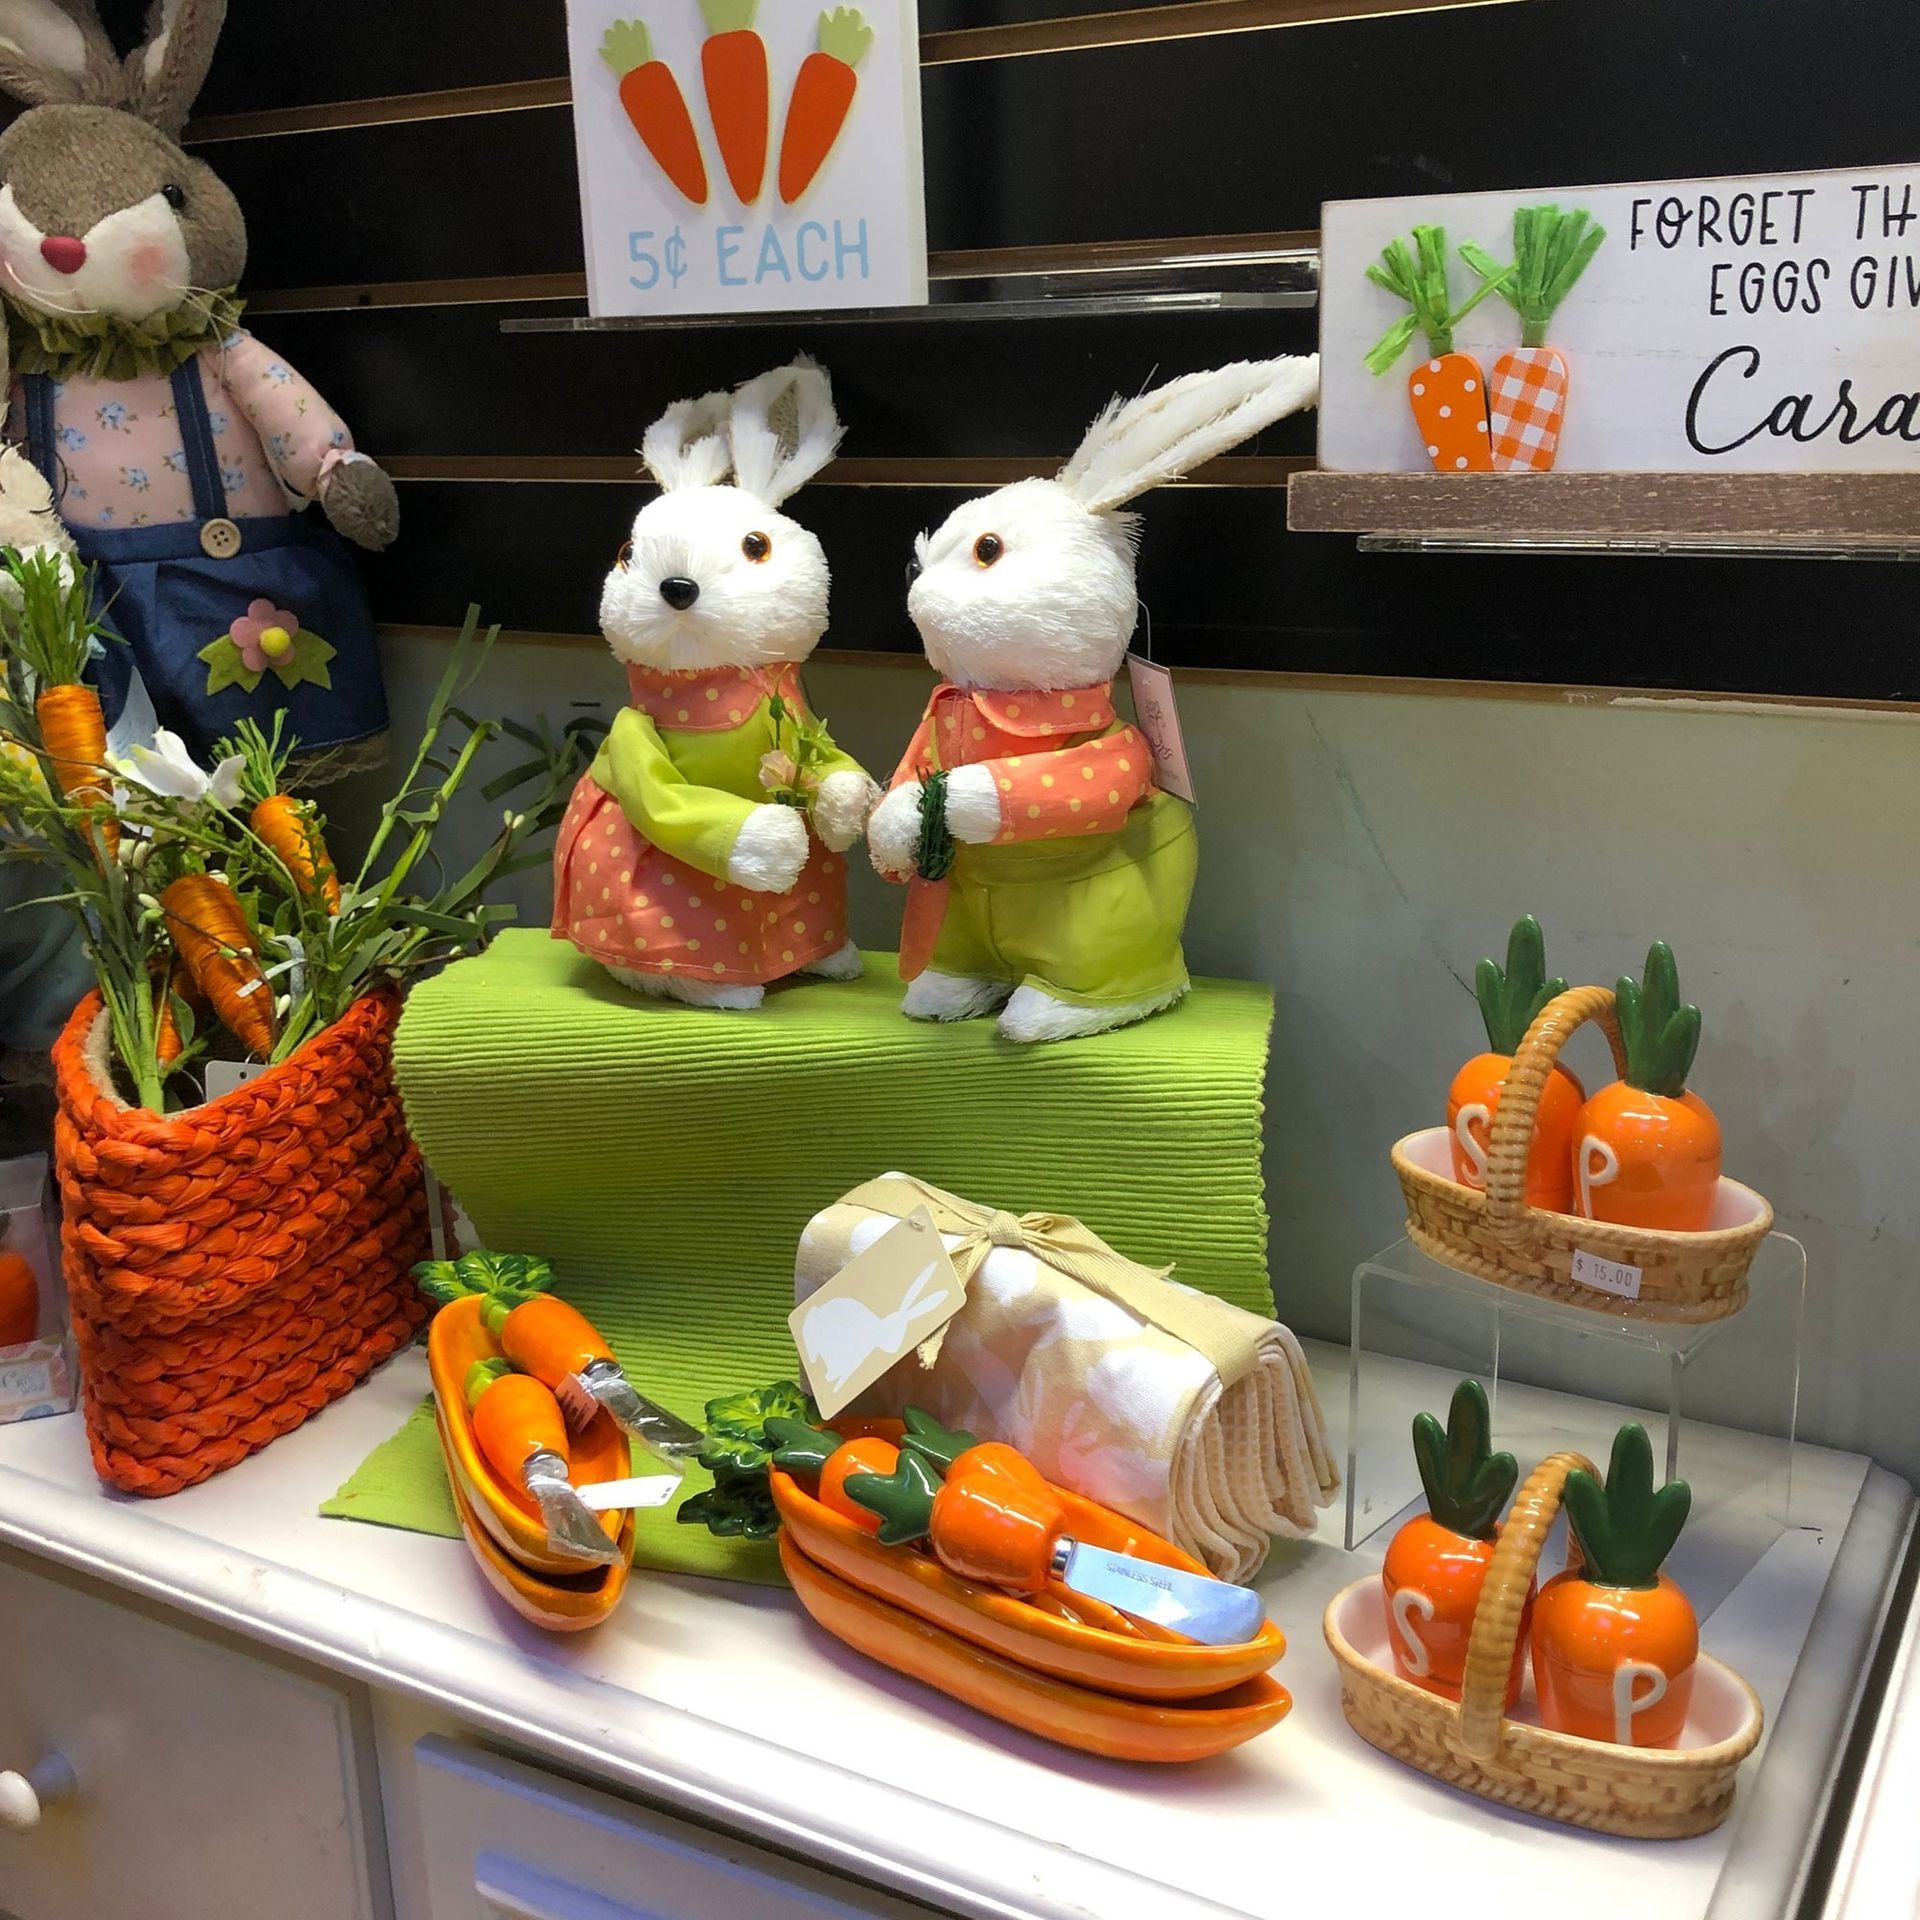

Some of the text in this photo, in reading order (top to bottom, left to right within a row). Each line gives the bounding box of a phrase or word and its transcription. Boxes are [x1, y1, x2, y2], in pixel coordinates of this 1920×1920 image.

[628, 218, 870, 290] 5¢ EACH
[1630, 188, 1815, 251] FORGET
[1709, 257, 1830, 316] EGGS
[1456, 1103, 1490, 1188] S
[1579, 1135, 1619, 1221] P
[1392, 1588, 1435, 1677] S
[1613, 1662, 1668, 1745] P
